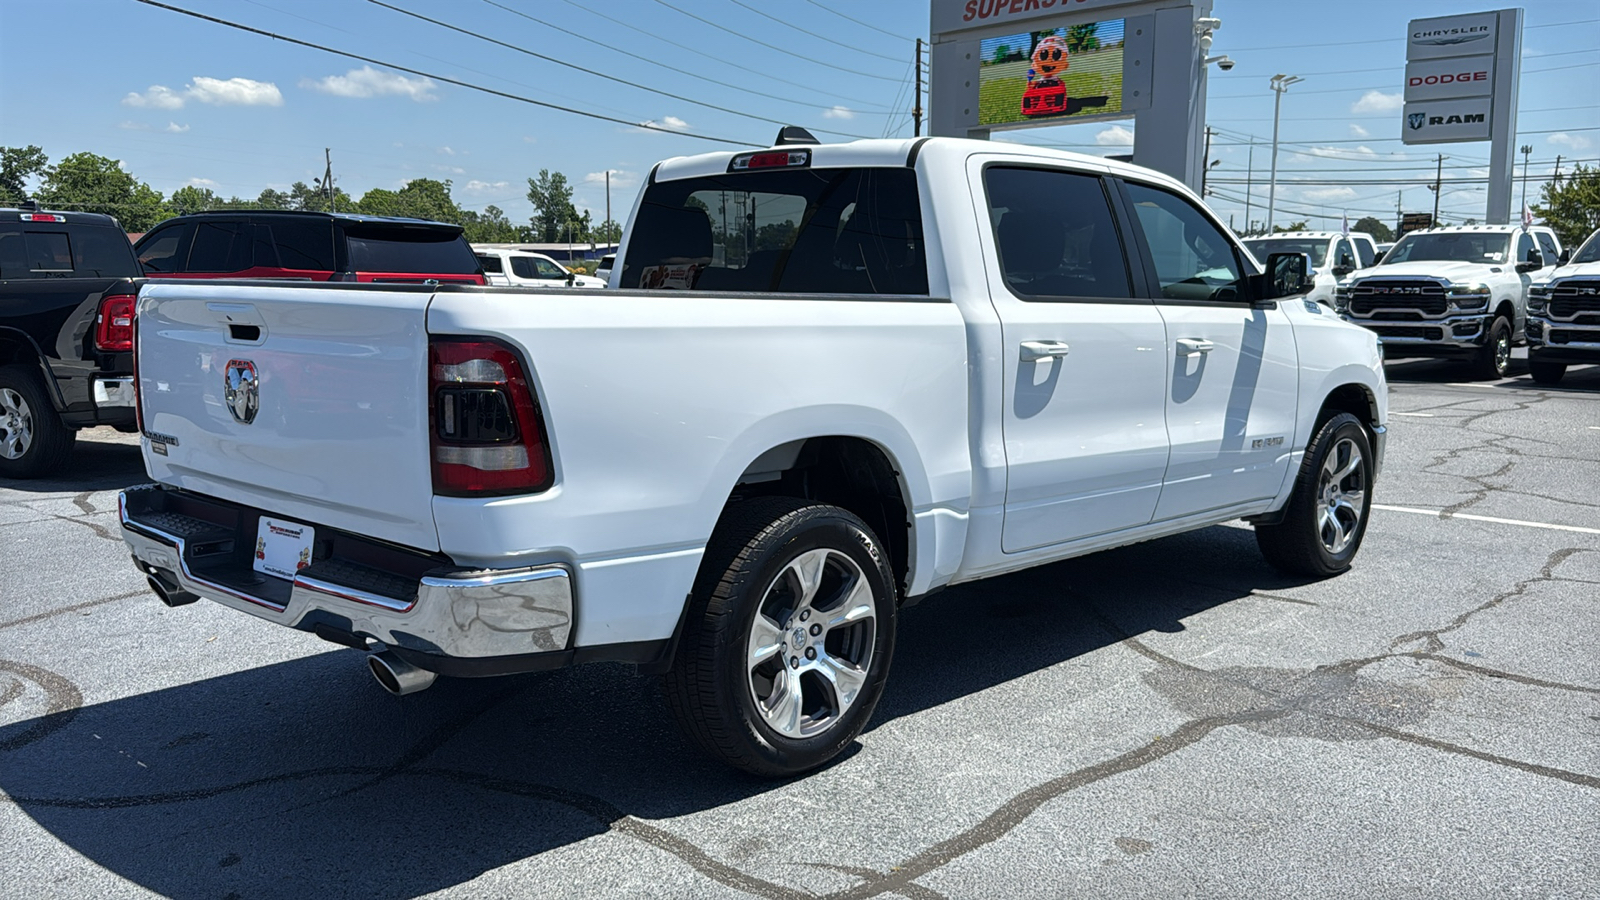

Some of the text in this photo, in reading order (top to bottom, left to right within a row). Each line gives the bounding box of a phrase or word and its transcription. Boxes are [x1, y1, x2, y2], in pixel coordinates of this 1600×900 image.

[963, 0, 1087, 22] SUPER
[1413, 26, 1488, 38] CHRYSLER
[1409, 71, 1488, 87] DODGE
[1428, 113, 1485, 125] RAM
